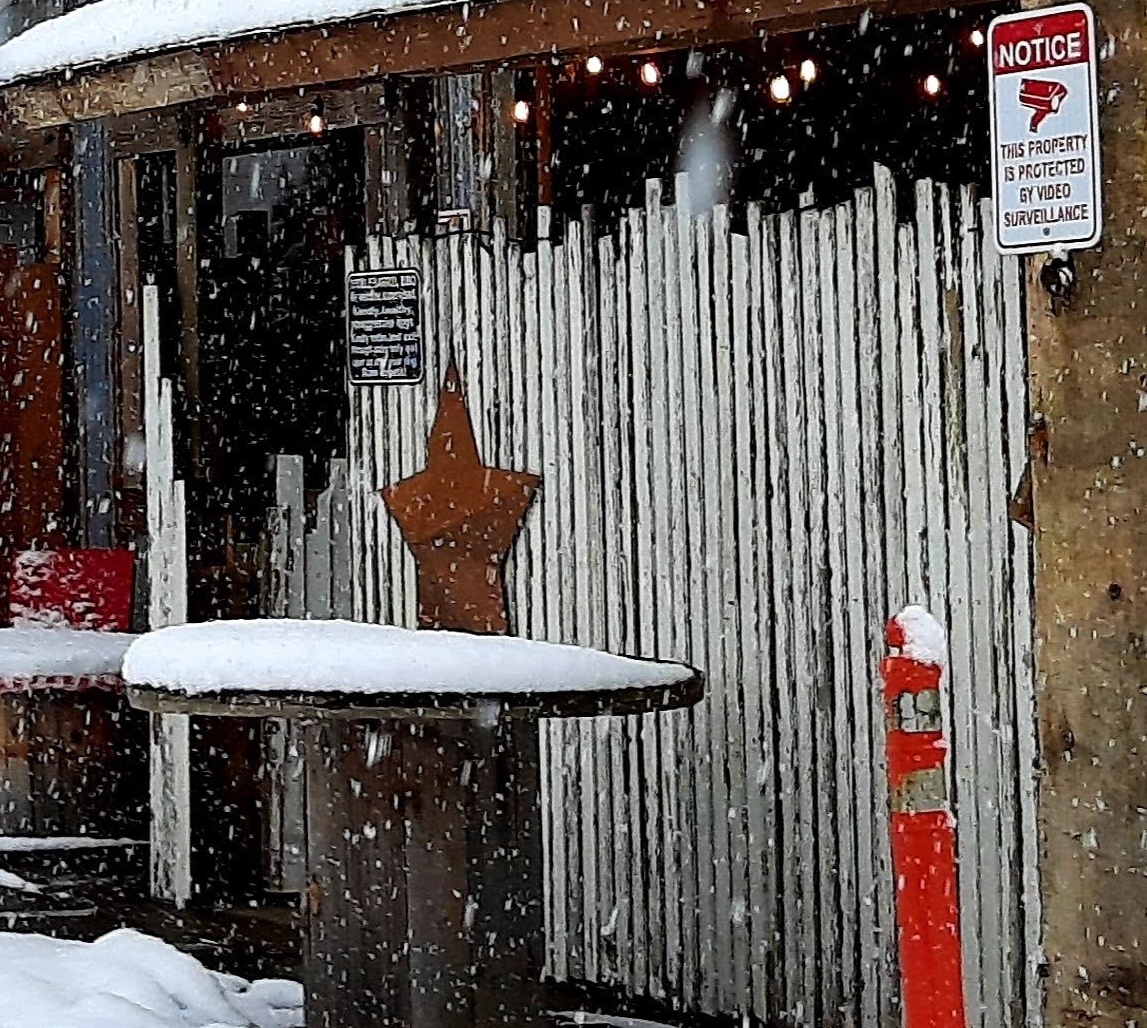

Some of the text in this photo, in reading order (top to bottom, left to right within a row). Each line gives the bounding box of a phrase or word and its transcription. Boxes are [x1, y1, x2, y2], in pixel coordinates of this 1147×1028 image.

[999, 32, 1081, 68] NOTICE
[1000, 134, 1087, 159] THIS PROPERTY
[1004, 158, 1085, 182] IS PROTECTED
[1037, 183, 1071, 201] VIDEO
[1004, 204, 1089, 227] SURVEILLANCE
